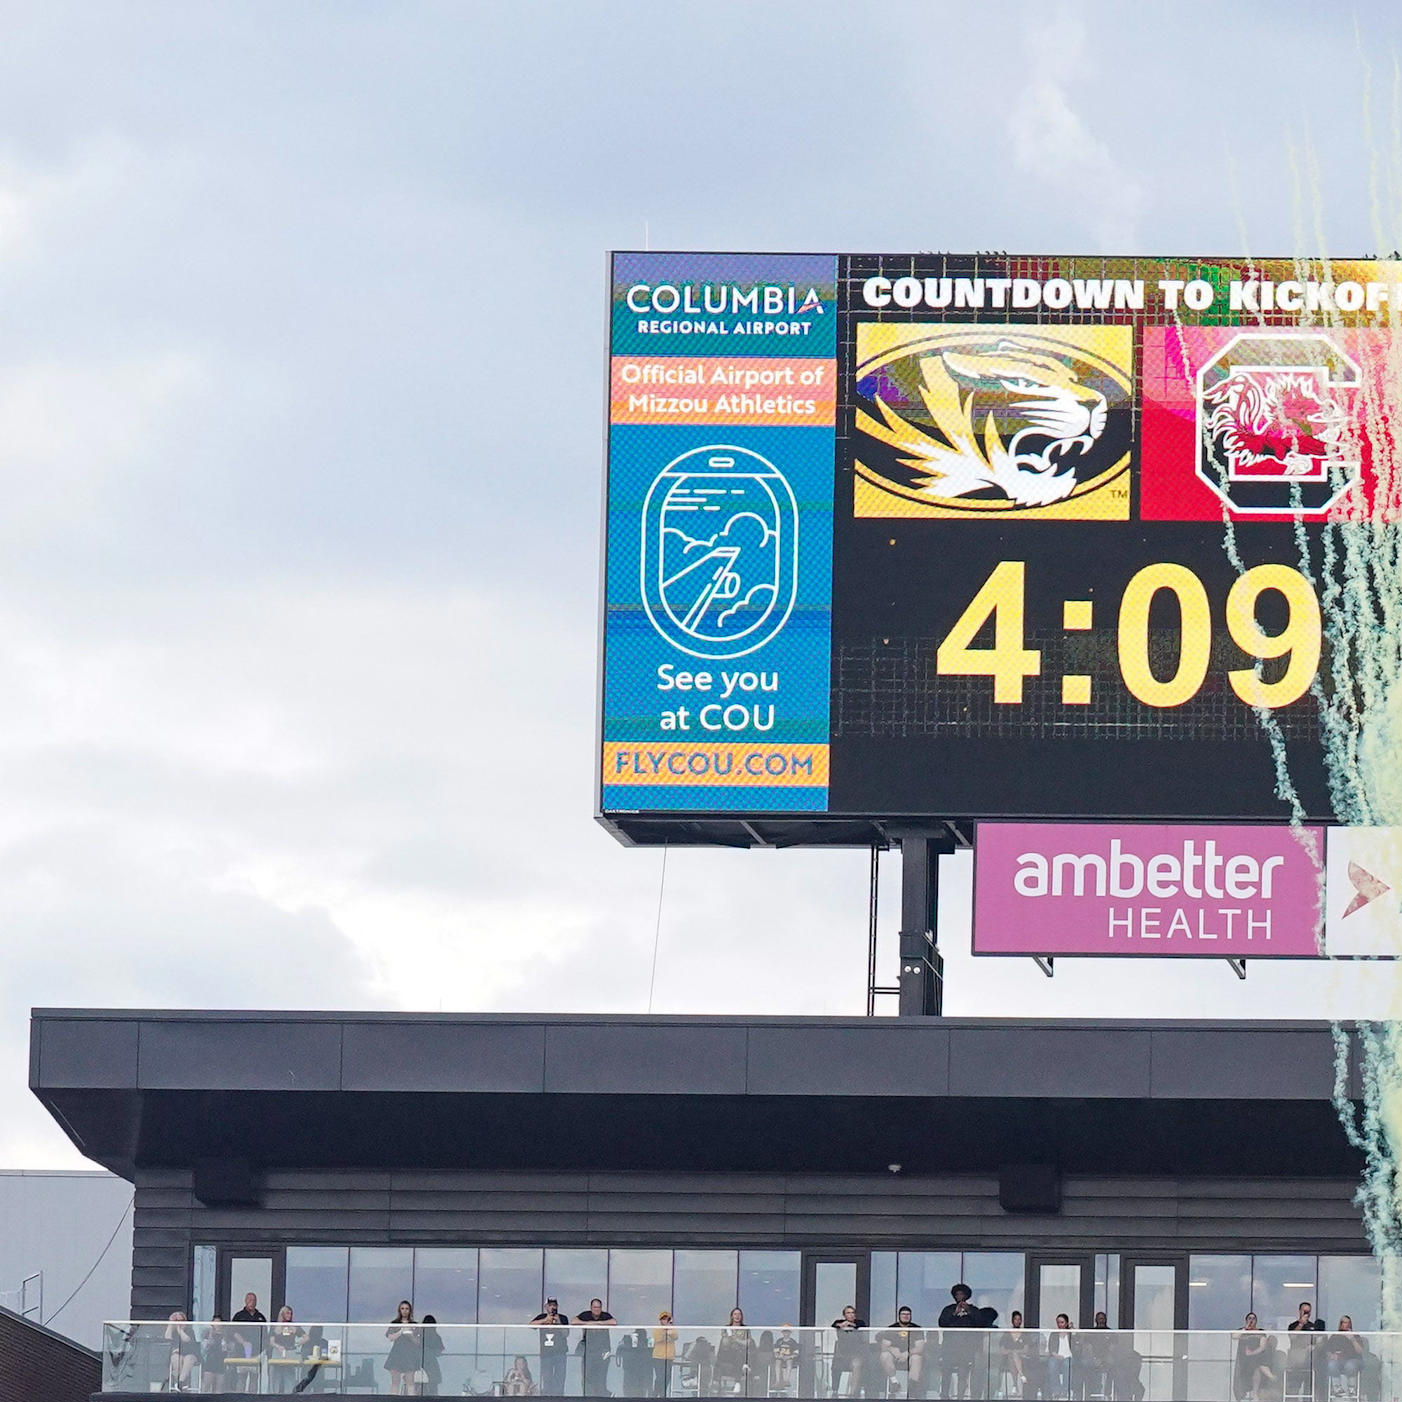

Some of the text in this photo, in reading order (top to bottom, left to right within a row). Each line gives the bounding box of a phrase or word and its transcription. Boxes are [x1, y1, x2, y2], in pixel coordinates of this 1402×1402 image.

[627, 284, 824, 314] COLUMBIA
[862, 277, 1144, 309] COUNTDOWN
[1158, 279, 1214, 310] TO
[638, 320, 811, 335] REGIONAL AIRPORT
[621, 364, 824, 389] Official Airport of
[629, 395, 815, 414] Mizzou Athletics
[937, 560, 1323, 709] 4:09
[657, 664, 779, 698] See you
[660, 704, 775, 731] at COU
[616, 752, 813, 775] FLYCOU.COM
[1013, 838, 1284, 898] ambetter
[1108, 908, 1272, 940] HEALTH
